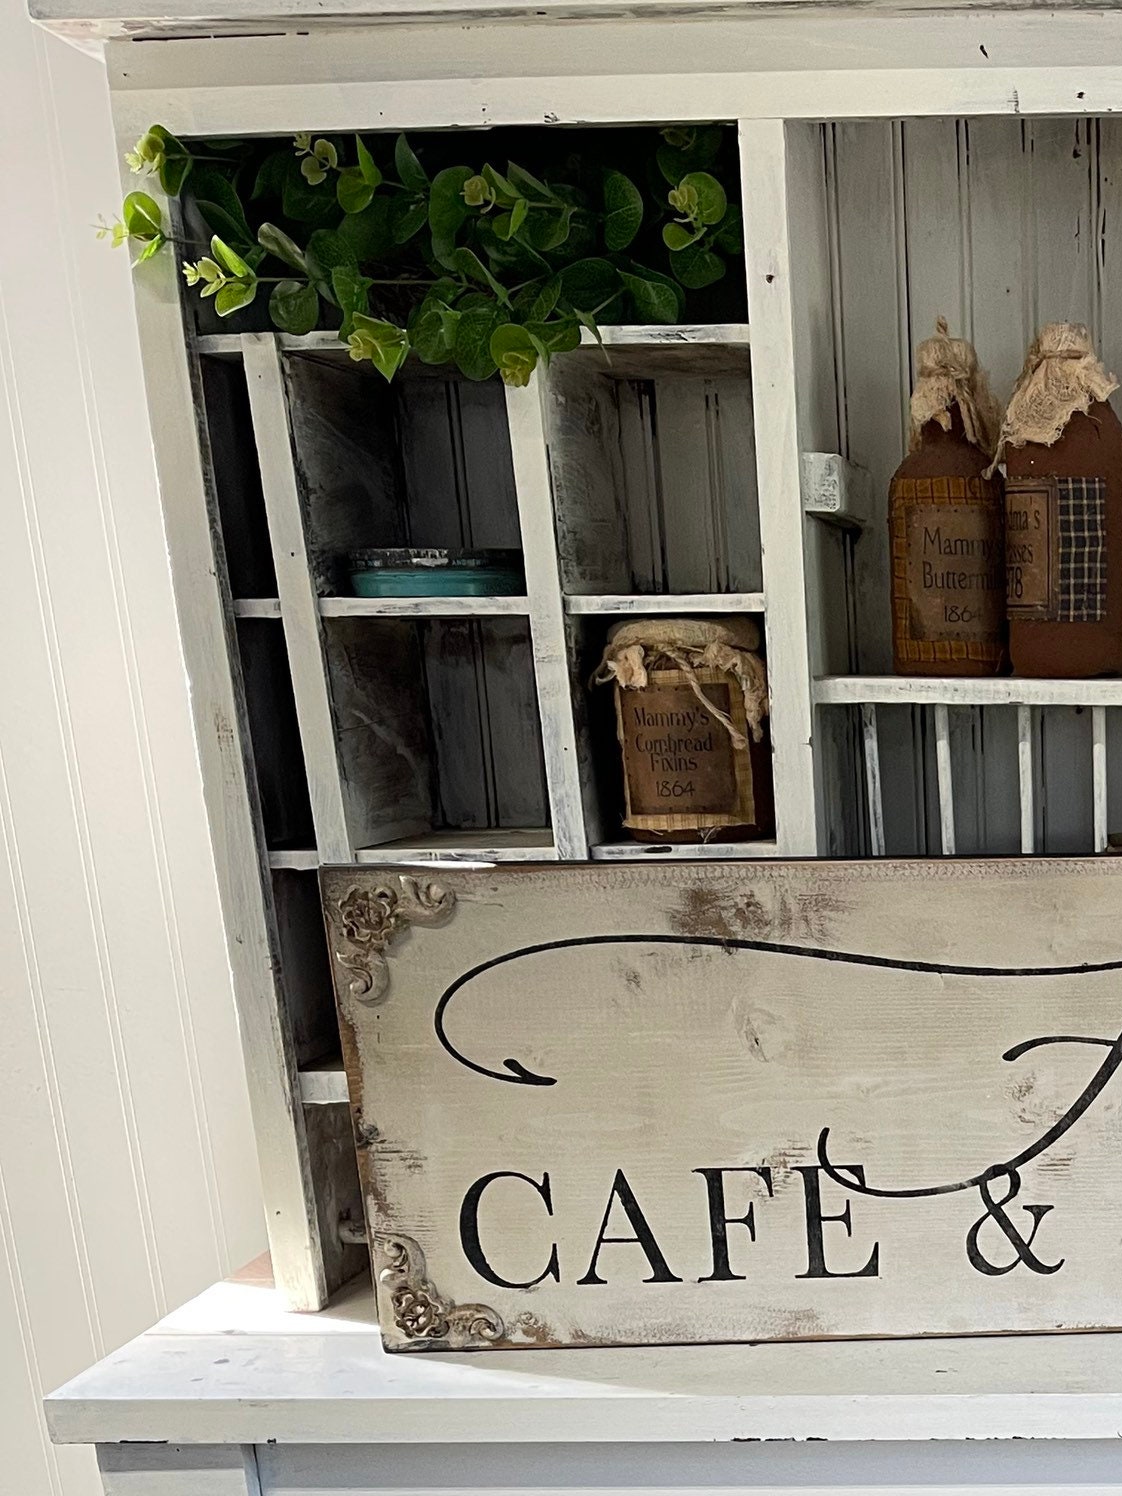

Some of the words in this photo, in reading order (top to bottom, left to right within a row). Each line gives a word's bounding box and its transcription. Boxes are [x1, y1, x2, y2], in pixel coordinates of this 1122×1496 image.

[633, 705, 710, 732] Mammy's
[655, 780, 696, 798] 1864
[965, 1163, 1066, 1278] &
